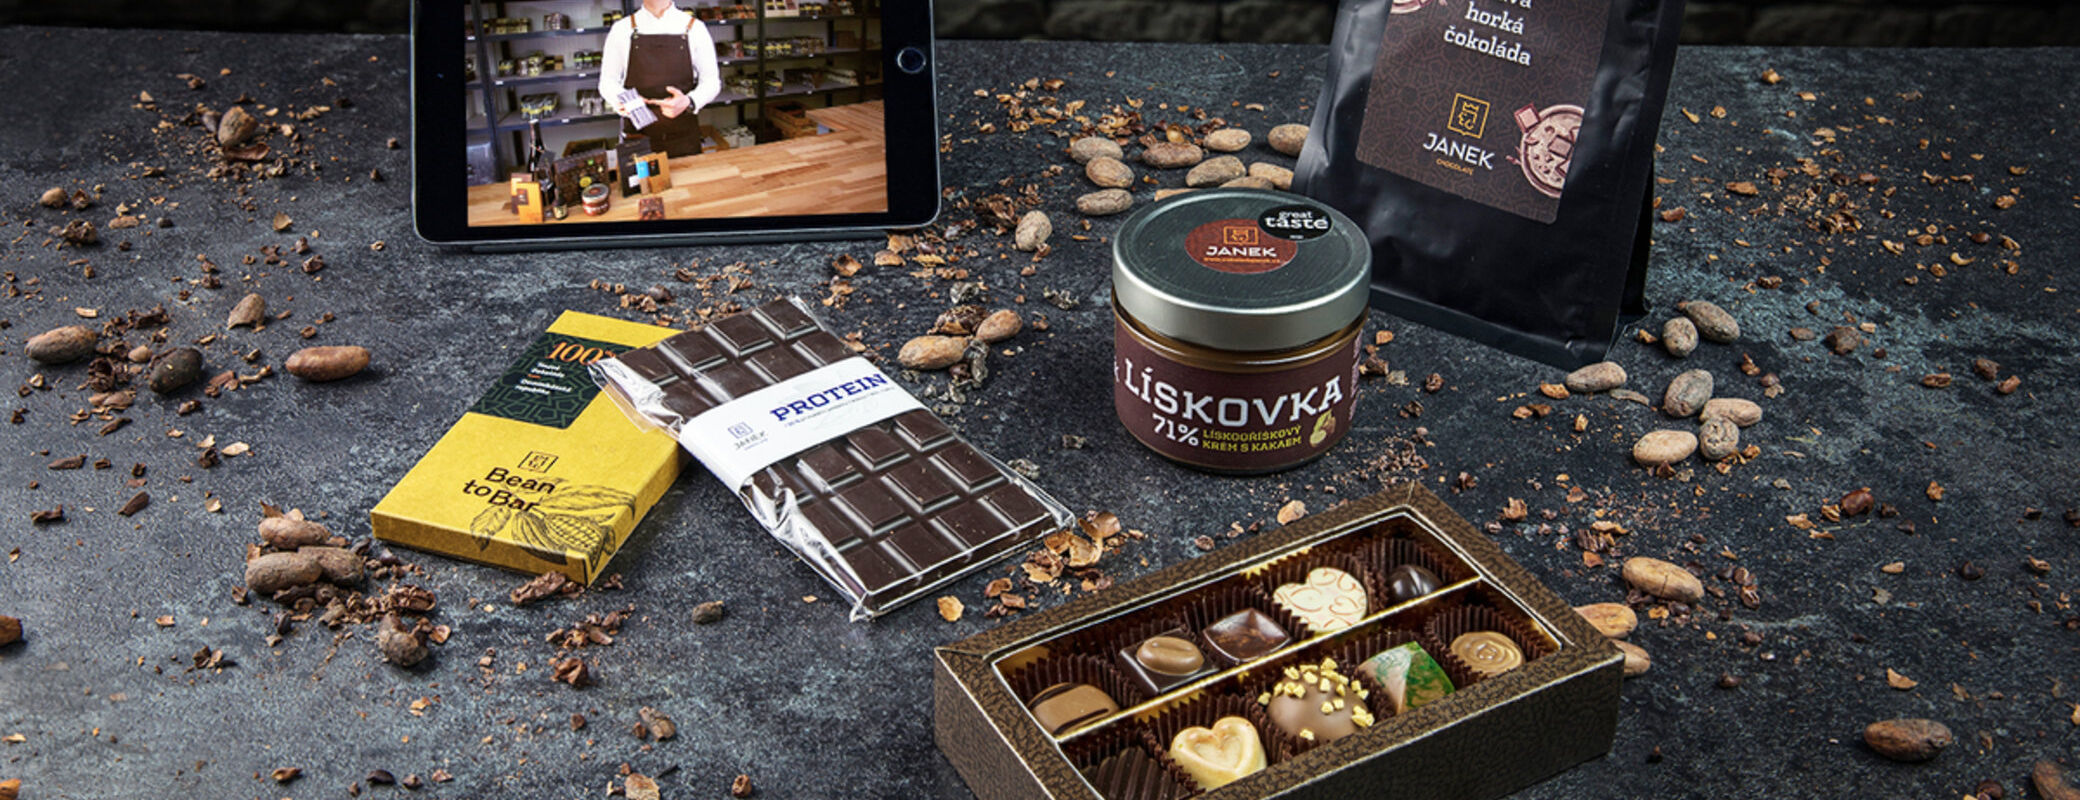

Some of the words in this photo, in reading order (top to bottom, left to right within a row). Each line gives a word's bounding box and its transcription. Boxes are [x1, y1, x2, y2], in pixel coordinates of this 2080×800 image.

[1464, 1, 1524, 35] horká
[1443, 25, 1532, 66] čokoláda
[1422, 132, 1496, 170] JANEK
[1264, 216, 1329, 230] taste
[1278, 210, 1313, 220] great
[1205, 245, 1278, 257] JANEK
[770, 373, 889, 422] PROTEIN
[1124, 357, 1344, 428] LÍSKOVKA
[1152, 413, 1200, 447] 71%
[484, 467, 556, 495] Bean
